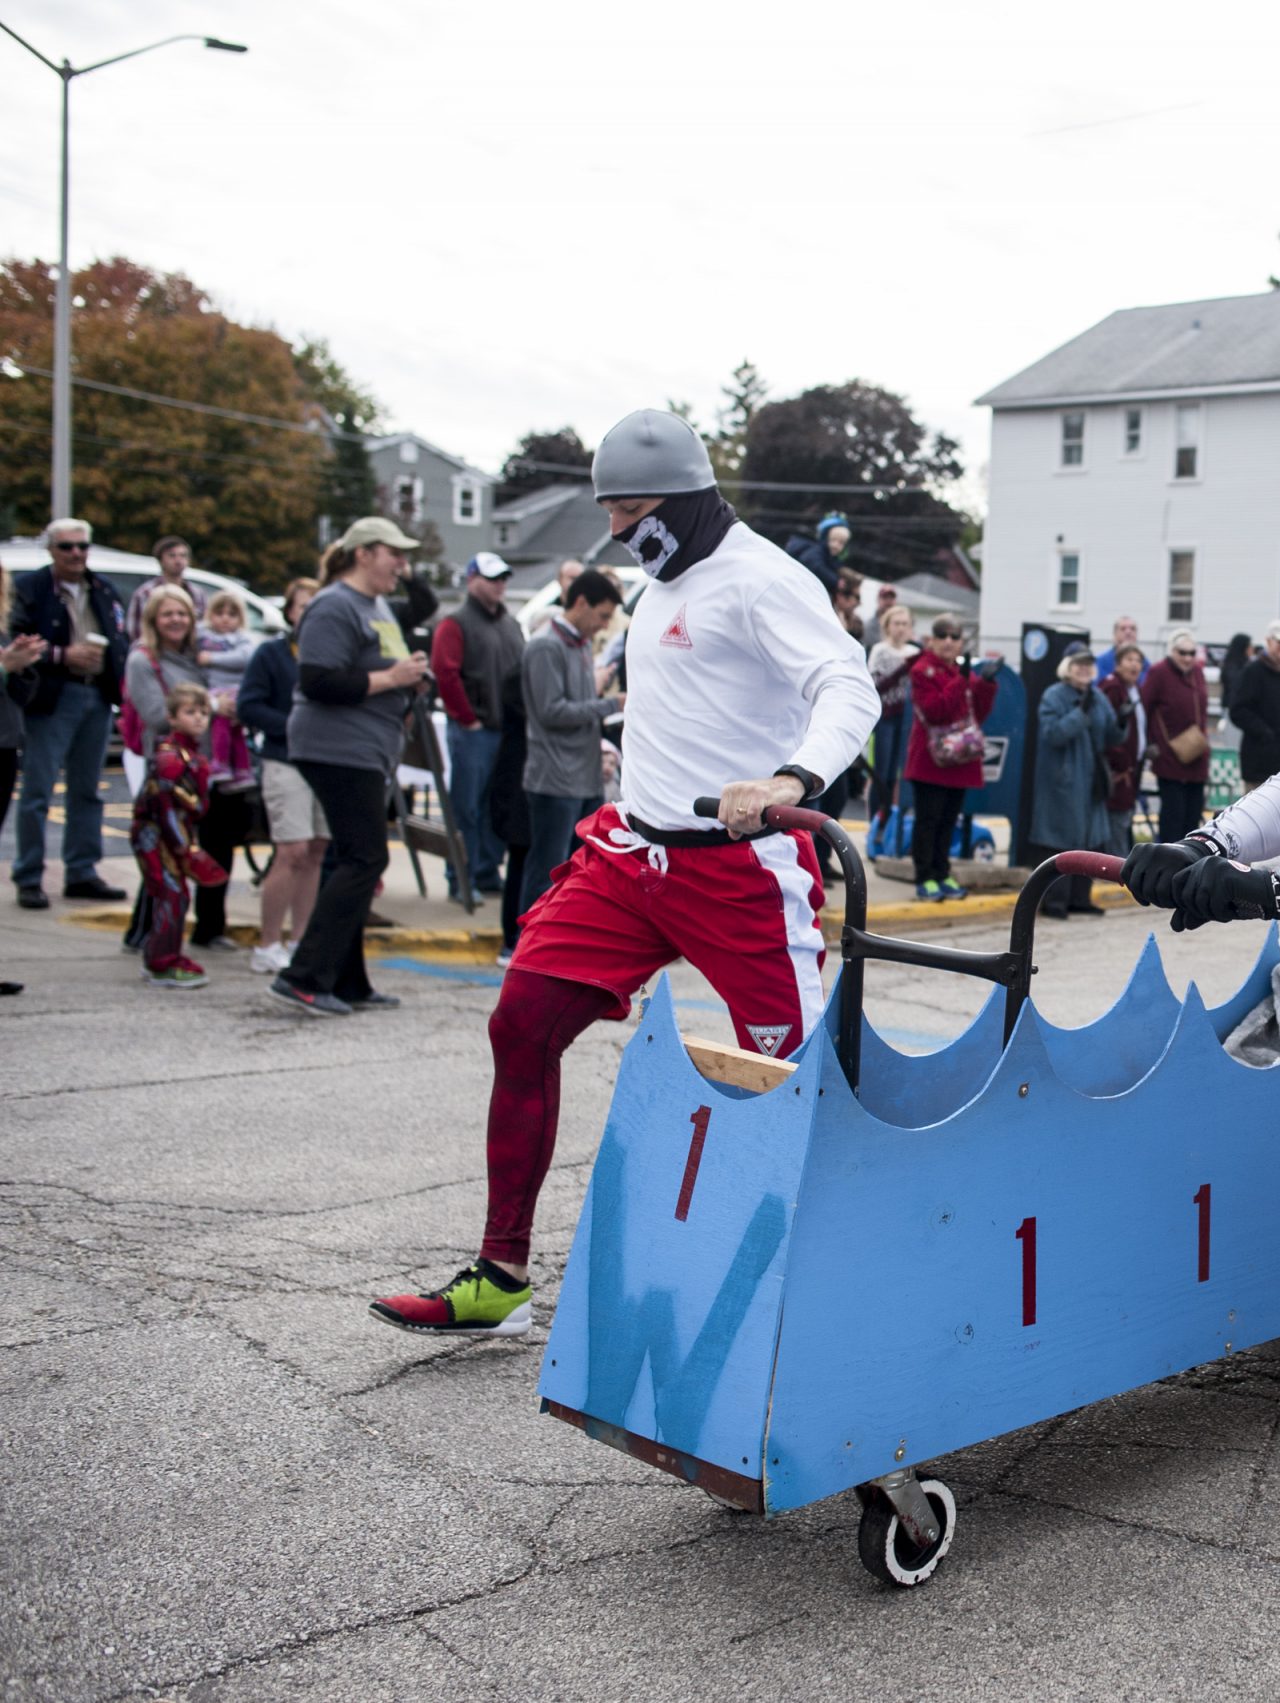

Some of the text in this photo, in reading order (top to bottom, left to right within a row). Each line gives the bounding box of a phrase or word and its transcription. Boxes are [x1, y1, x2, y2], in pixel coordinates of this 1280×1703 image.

[675, 1105, 712, 1222] 1
[1016, 1217, 1037, 1327] 1
[1193, 1184, 1211, 1282] 1
